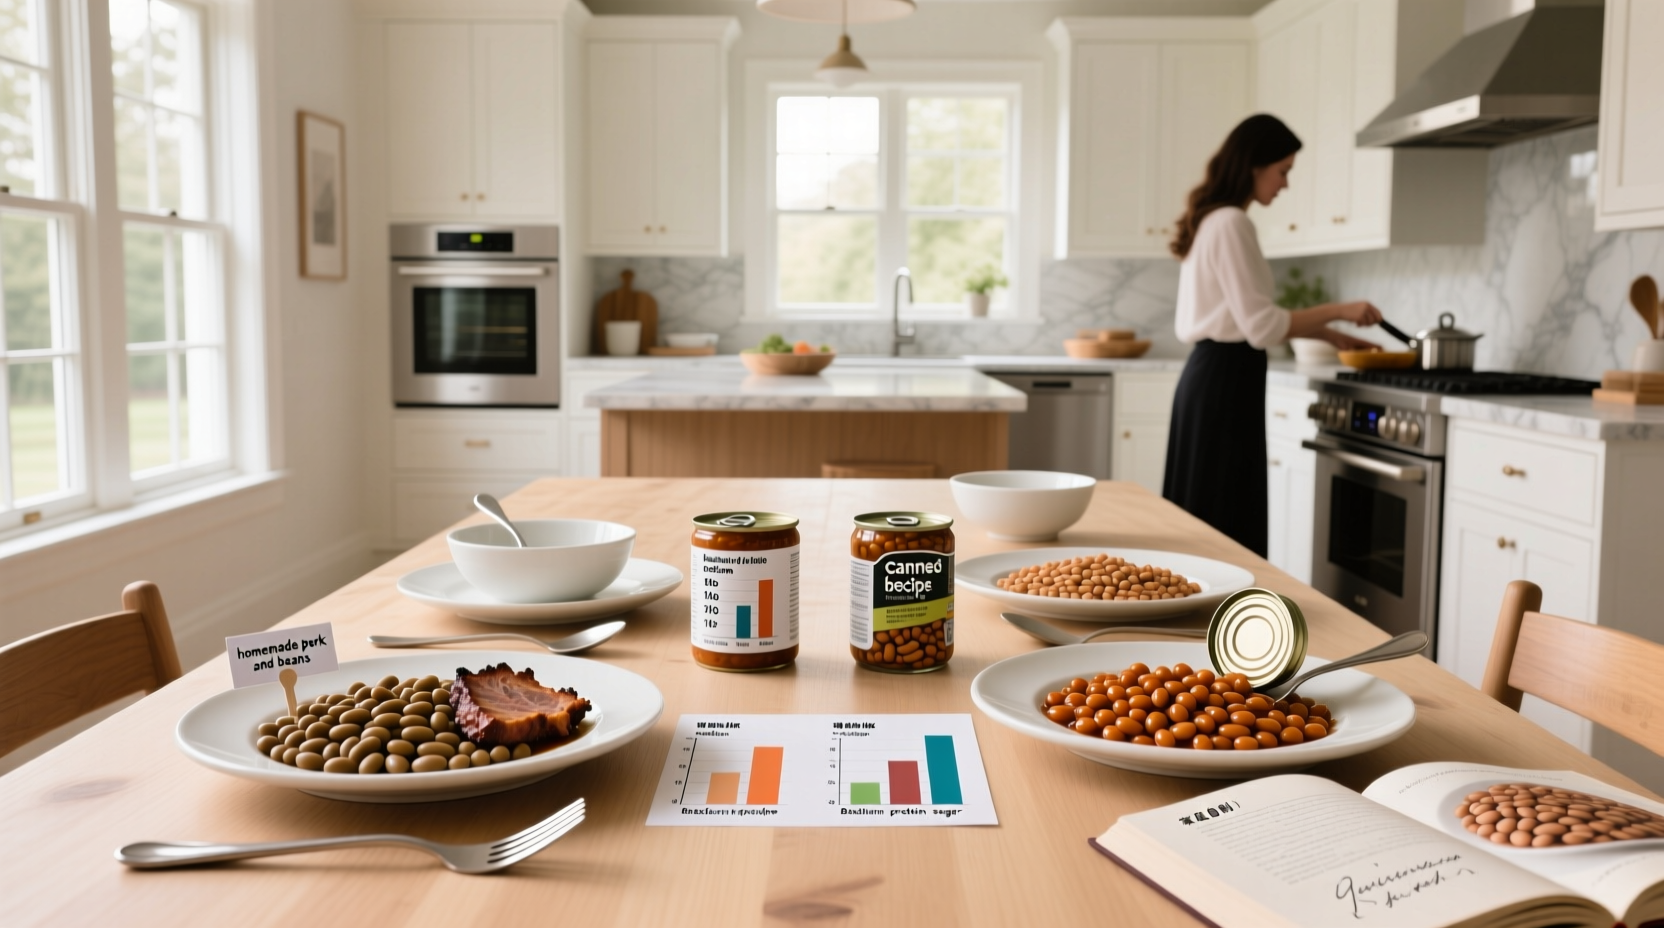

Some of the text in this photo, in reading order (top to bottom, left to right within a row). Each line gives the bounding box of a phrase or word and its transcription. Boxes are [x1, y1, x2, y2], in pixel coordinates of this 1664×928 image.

[885, 558, 942, 575] Canned
[237, 638, 299, 660] homemade
[253, 654, 312, 672] and beans
